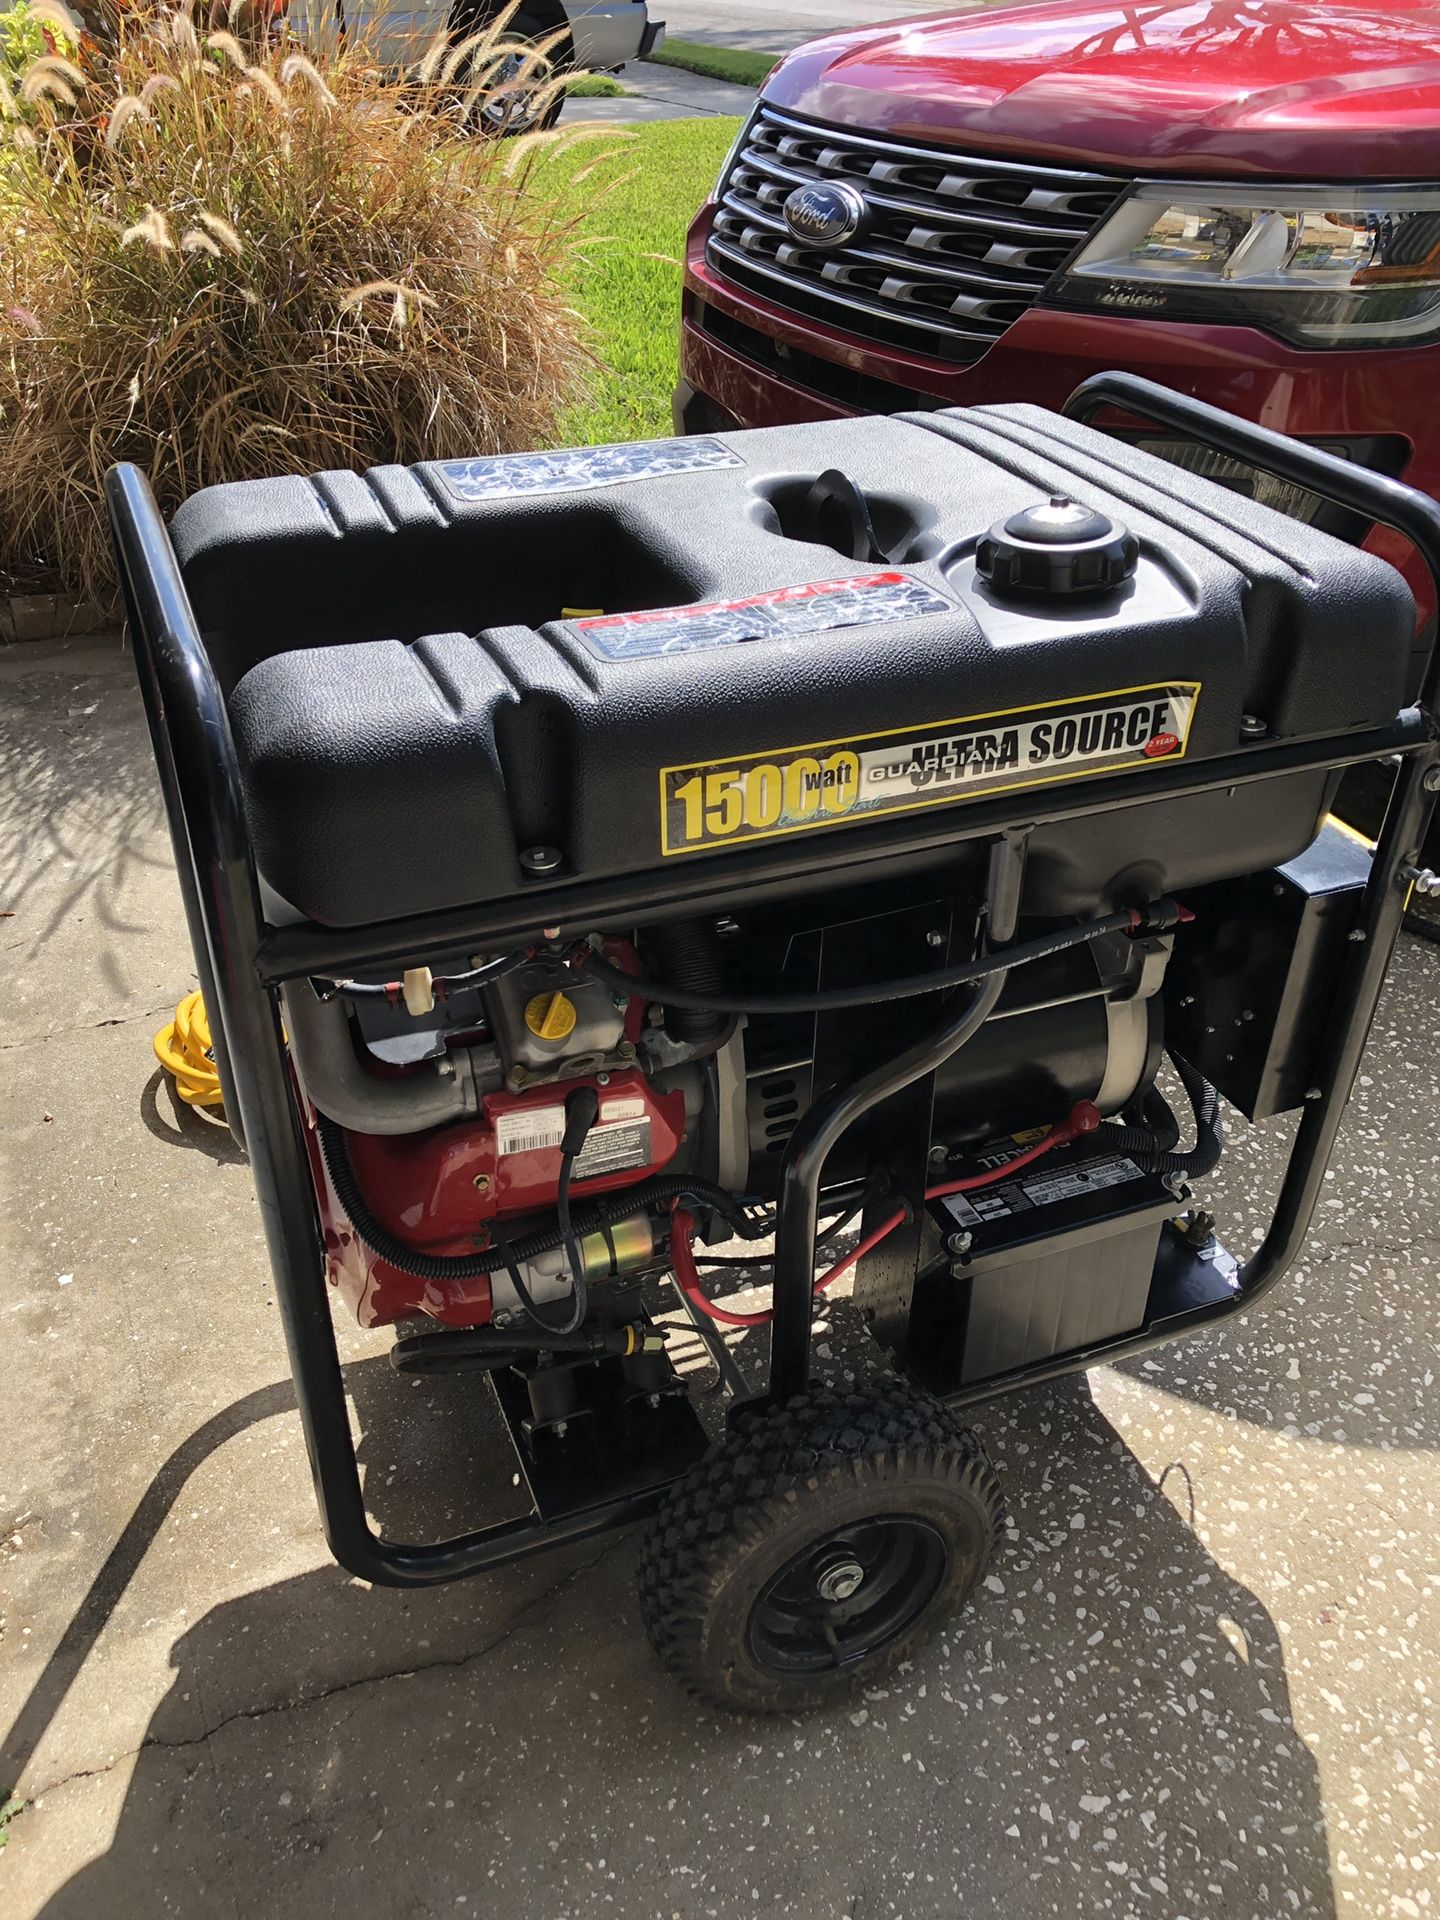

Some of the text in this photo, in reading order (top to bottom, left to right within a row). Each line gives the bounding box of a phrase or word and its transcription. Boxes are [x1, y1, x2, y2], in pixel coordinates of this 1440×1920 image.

[792, 191, 836, 230] Ford
[910, 702, 1170, 786] ULTRA SOURCE
[1155, 736, 1175, 746] YEAR
[805, 764, 853, 791] watt
[868, 746, 1002, 781] GUARDIAN
